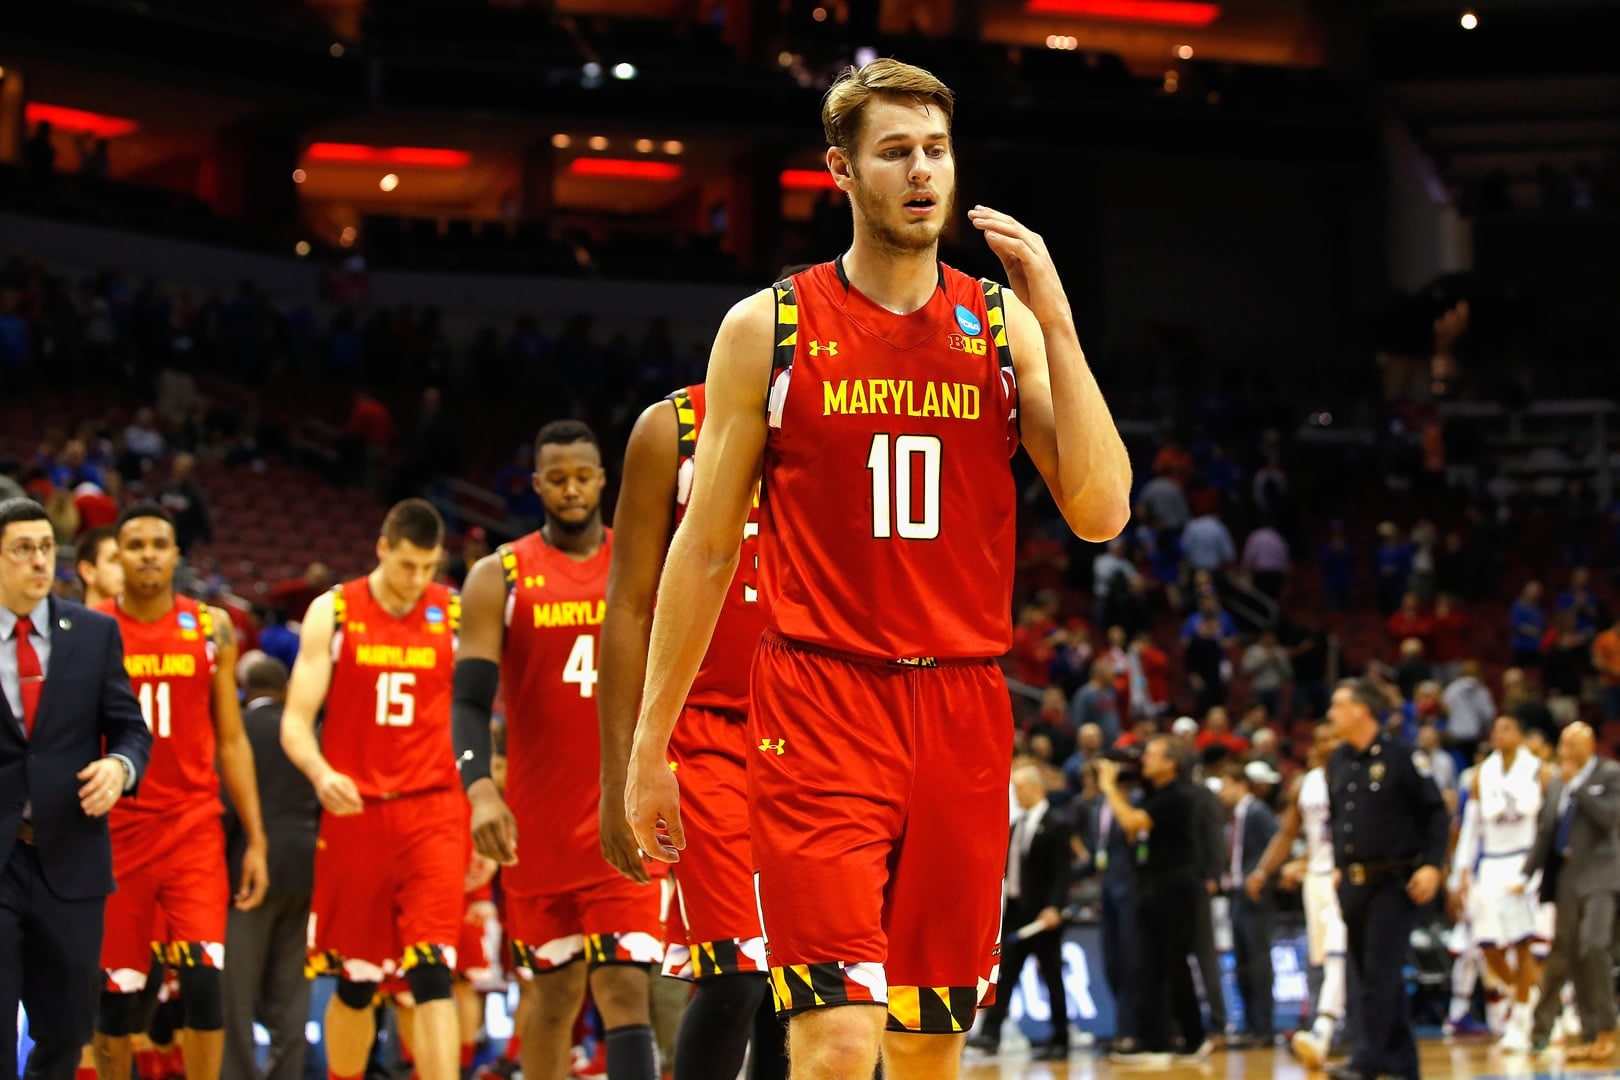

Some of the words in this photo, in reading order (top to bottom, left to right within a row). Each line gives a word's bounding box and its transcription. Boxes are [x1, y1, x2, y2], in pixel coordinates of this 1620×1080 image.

[822, 379, 980, 420] MARYLAND
[866, 433, 942, 540] 10
[532, 599, 606, 629] MARYLA
[124, 653, 196, 678] ARYLAND
[355, 644, 437, 669] MARYLAND
[562, 634, 598, 698] 4
[138, 681, 171, 738] 11
[375, 671, 417, 727] 15
